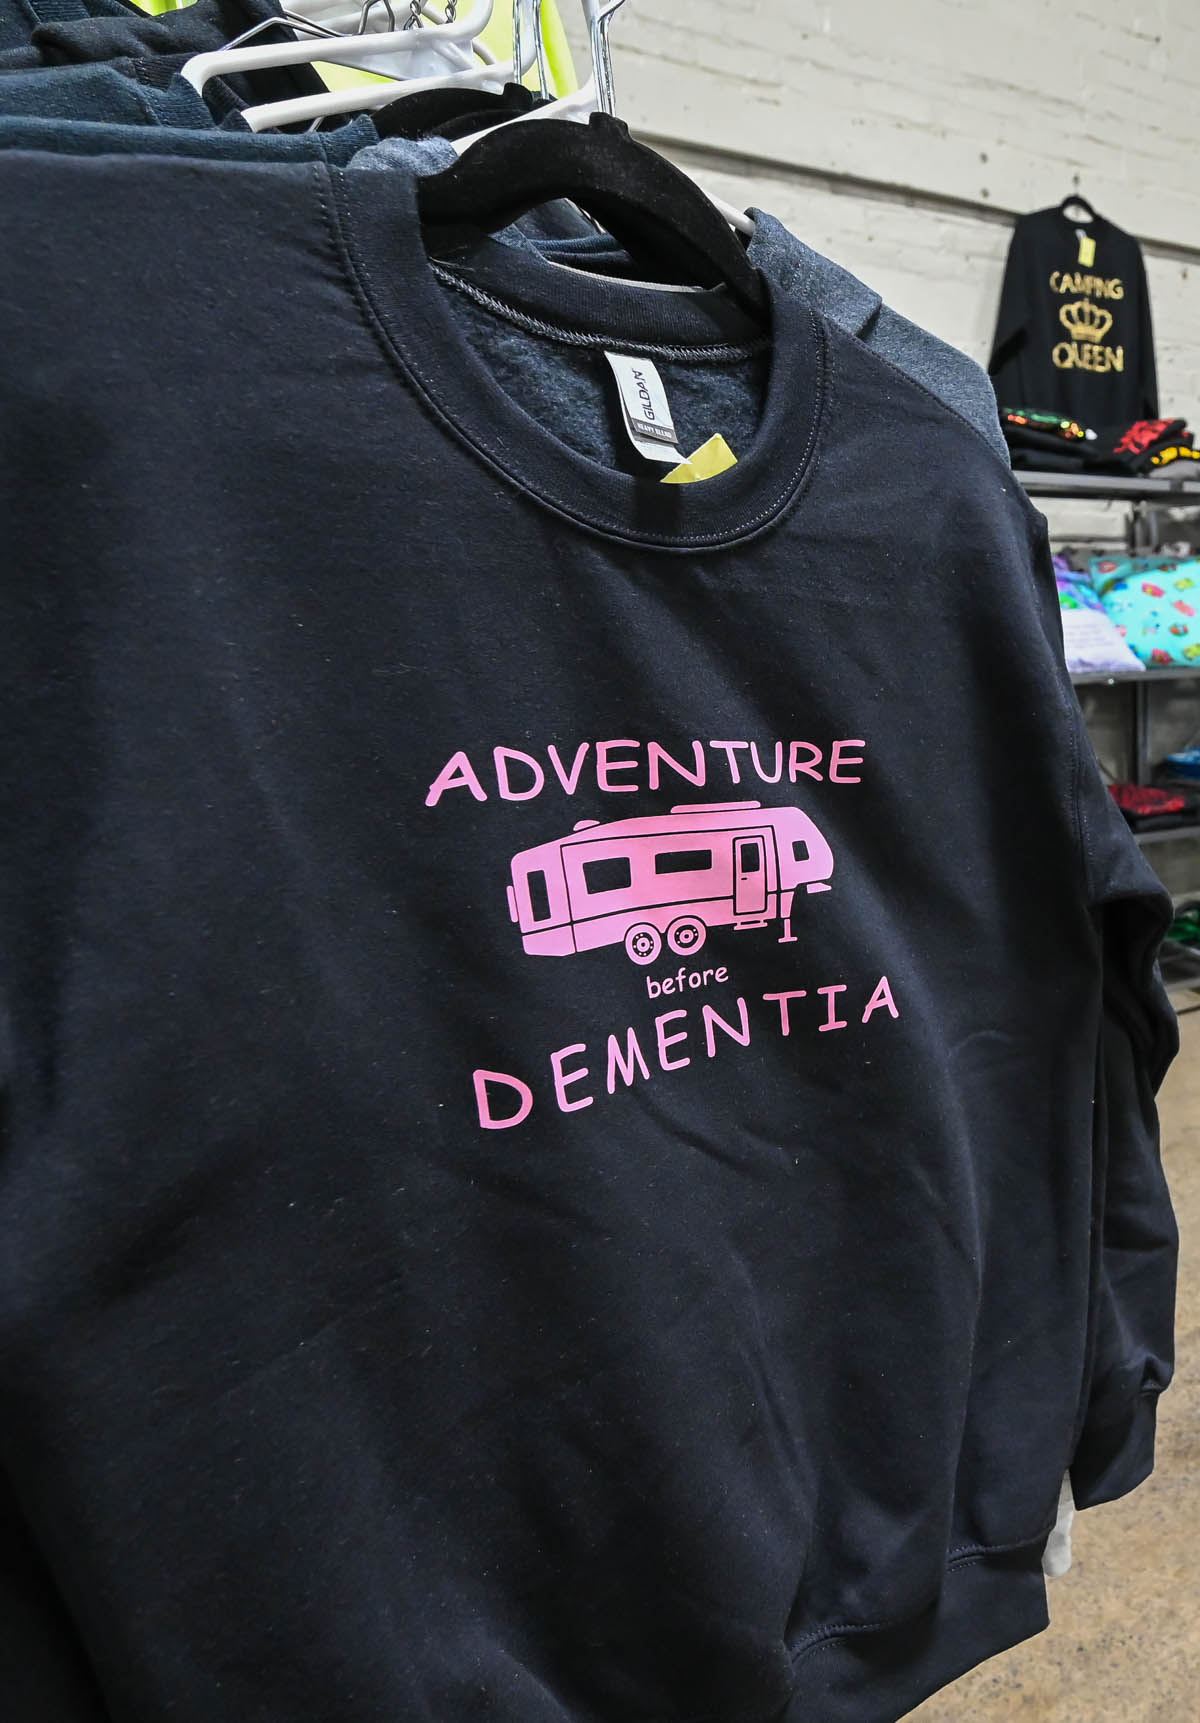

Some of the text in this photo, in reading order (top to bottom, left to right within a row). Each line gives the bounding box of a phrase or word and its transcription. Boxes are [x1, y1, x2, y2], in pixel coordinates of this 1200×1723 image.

[1049, 270, 1125, 300] CAMPING
[1051, 341, 1124, 373] QUEEN
[633, 370, 655, 421] GILDAN
[425, 739, 866, 807] ADVENTURE
[646, 963, 730, 999] before
[473, 975, 900, 1130] DEMENTIA
